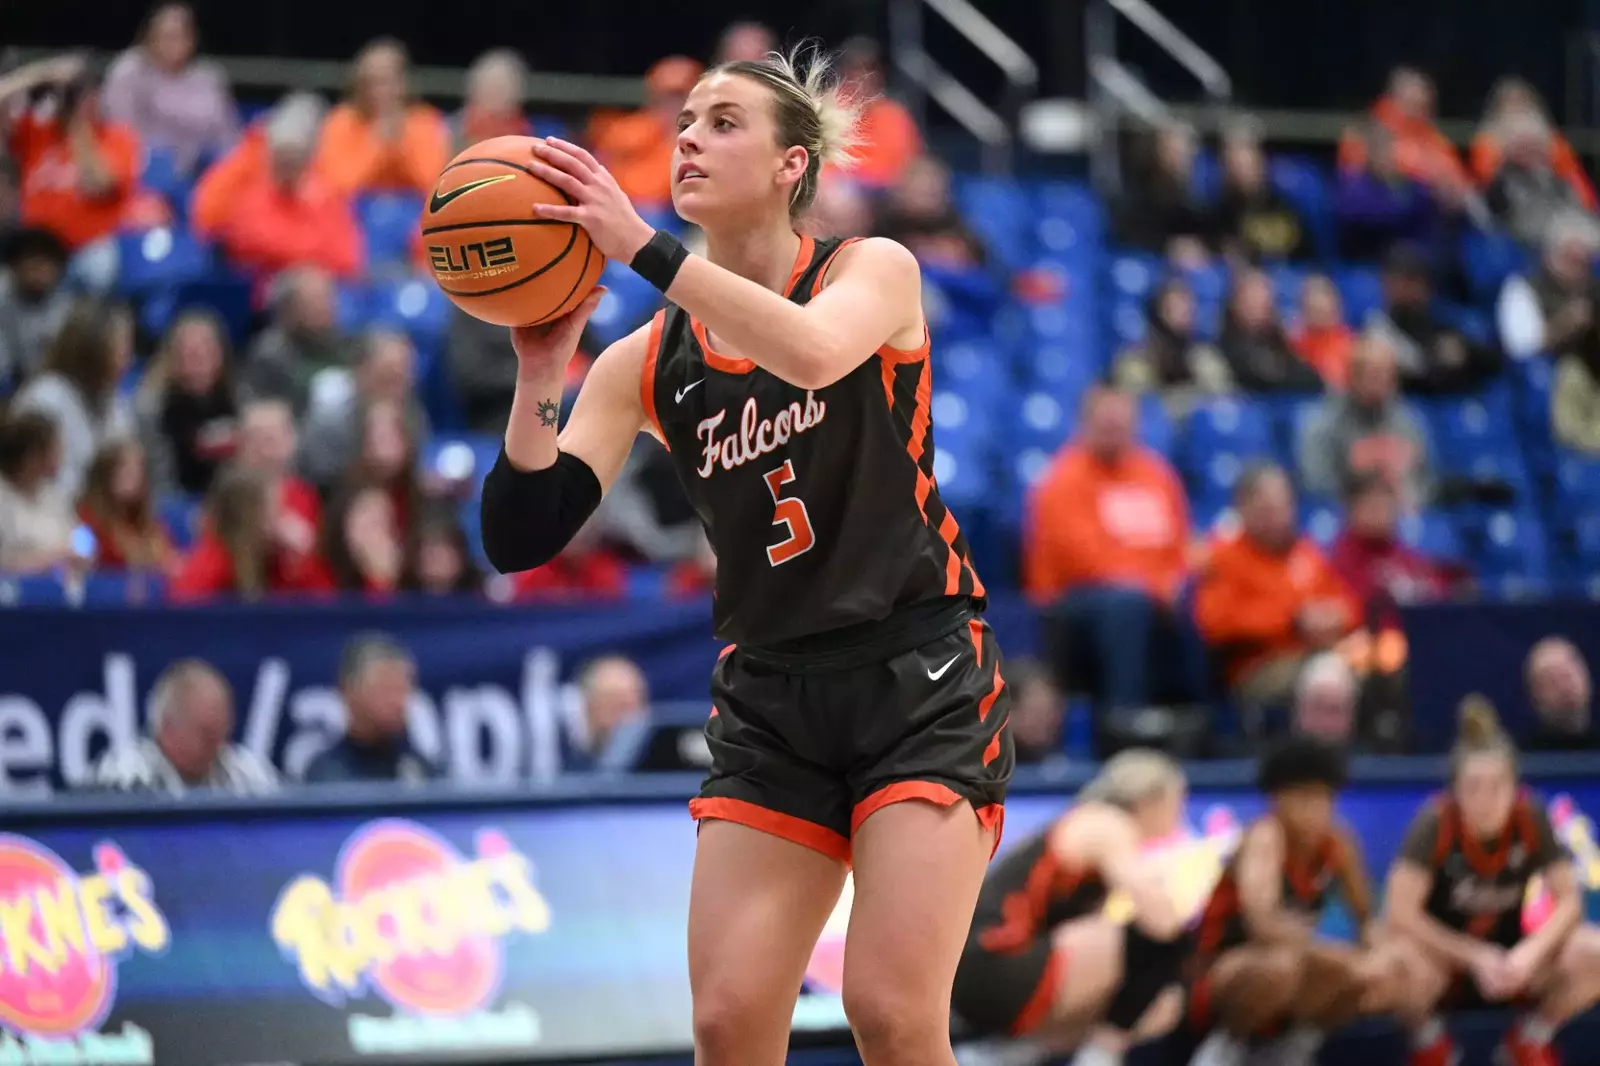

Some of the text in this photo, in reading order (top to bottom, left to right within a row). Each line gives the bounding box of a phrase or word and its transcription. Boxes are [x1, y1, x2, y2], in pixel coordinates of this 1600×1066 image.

[428, 236, 517, 273] ELITE
[435, 264, 520, 281] CHAMPIONSHIP
[696, 390, 826, 479] Falcons
[763, 458, 816, 568] 5
